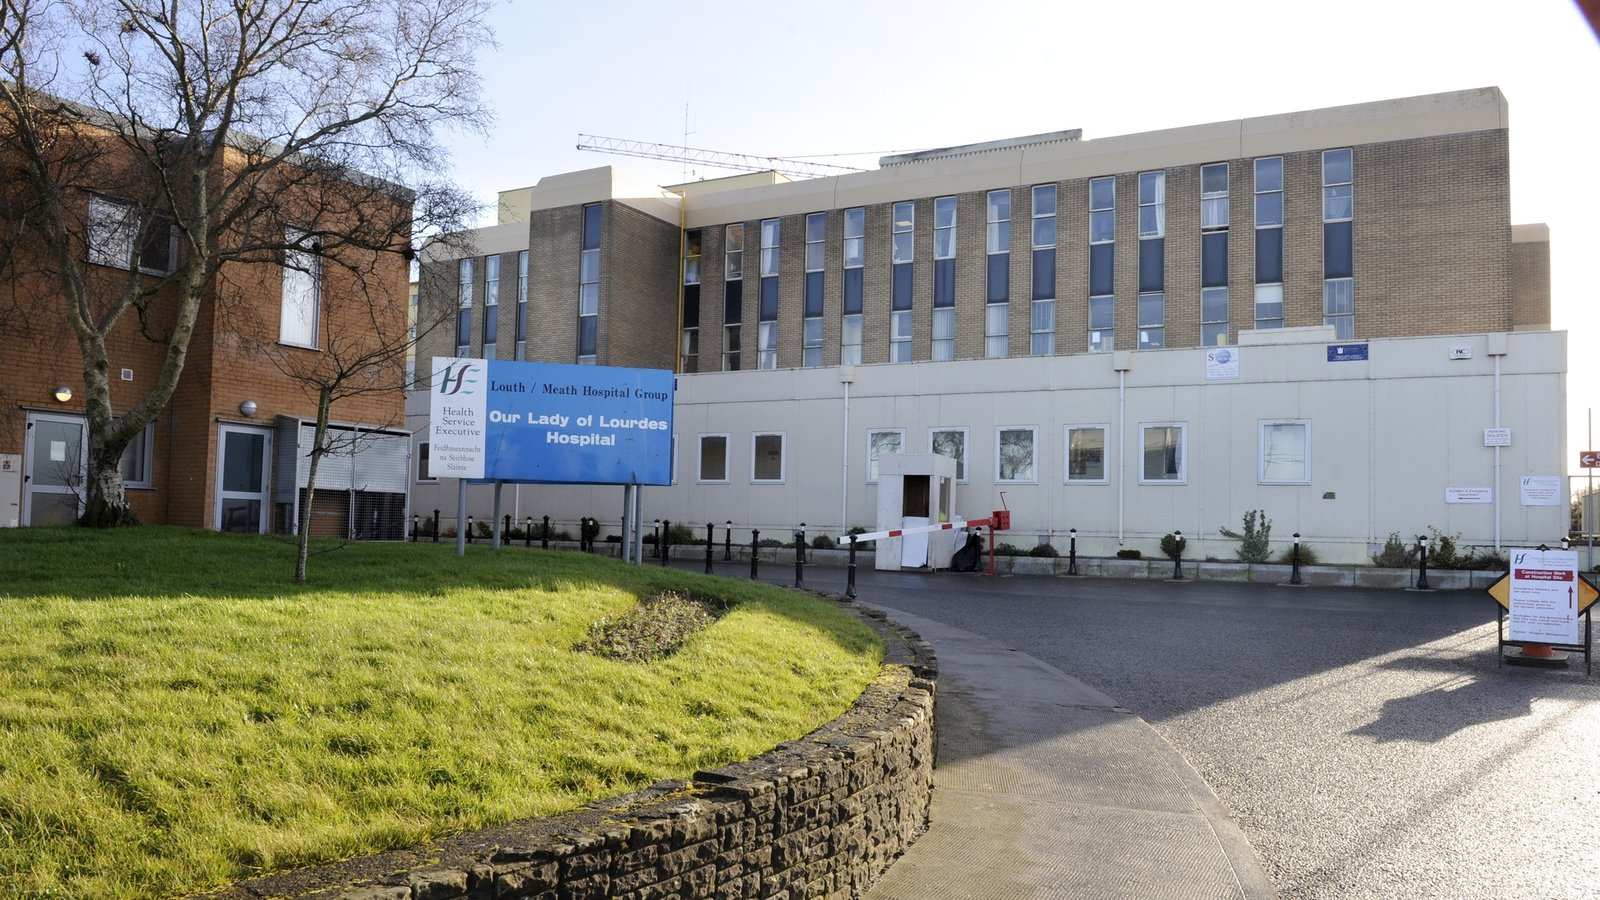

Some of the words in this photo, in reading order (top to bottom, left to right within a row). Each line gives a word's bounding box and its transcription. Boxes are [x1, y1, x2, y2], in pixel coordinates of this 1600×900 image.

[491, 381, 525, 393] Louth
[542, 384, 578, 396] Meath
[583, 386, 630, 399] Hospital
[634, 388, 669, 401] Group
[443, 406, 474, 417] Health
[442, 416, 475, 426] Service
[489, 410, 521, 424] Our
[527, 412, 569, 427] Lady
[576, 414, 593, 427] of
[599, 416, 668, 430] Lourdes
[436, 426, 481, 436] Executive
[546, 431, 616, 447] Hospital
